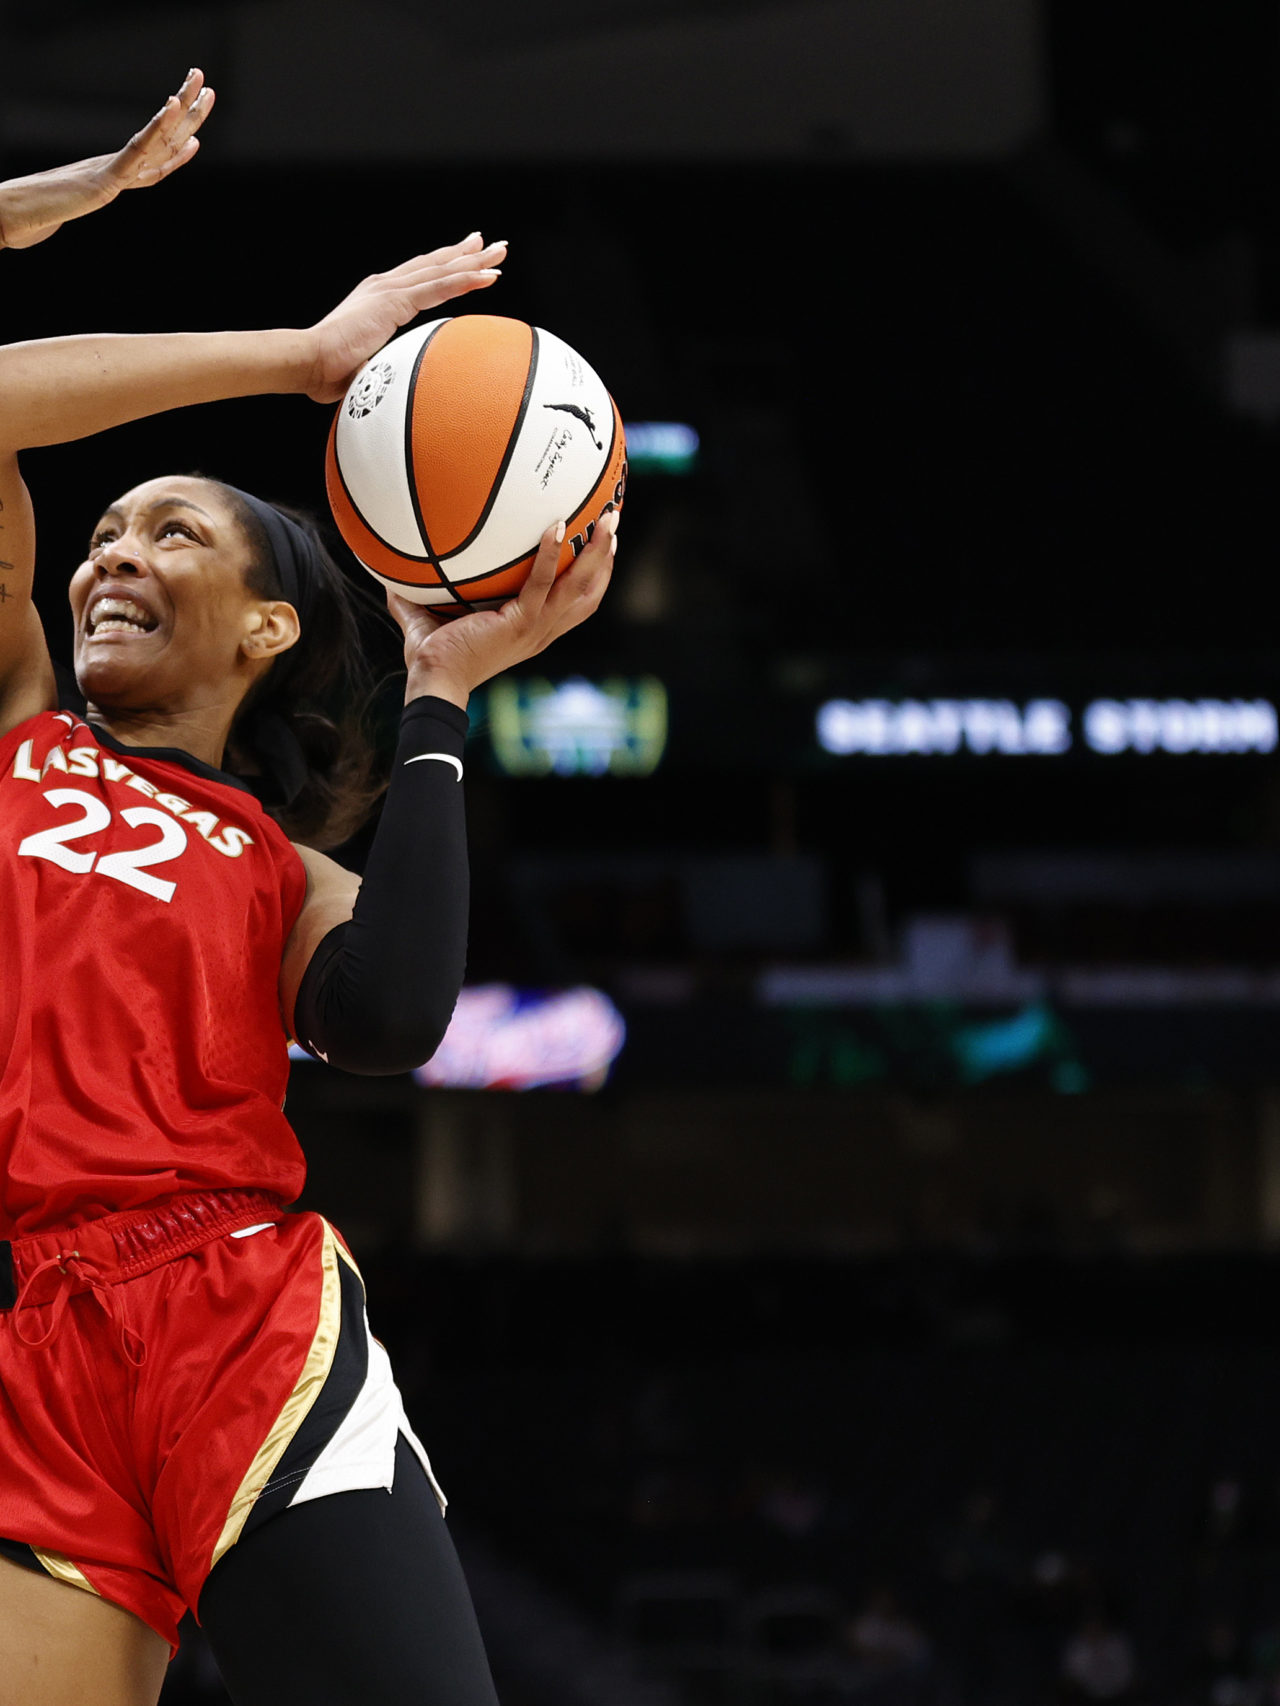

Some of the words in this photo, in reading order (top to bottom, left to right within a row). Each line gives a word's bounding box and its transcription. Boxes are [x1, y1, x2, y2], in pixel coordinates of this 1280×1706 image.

[817, 699, 1072, 756] SEATTLE
[1083, 699, 1278, 755] STORM
[18, 788, 188, 903] 22
